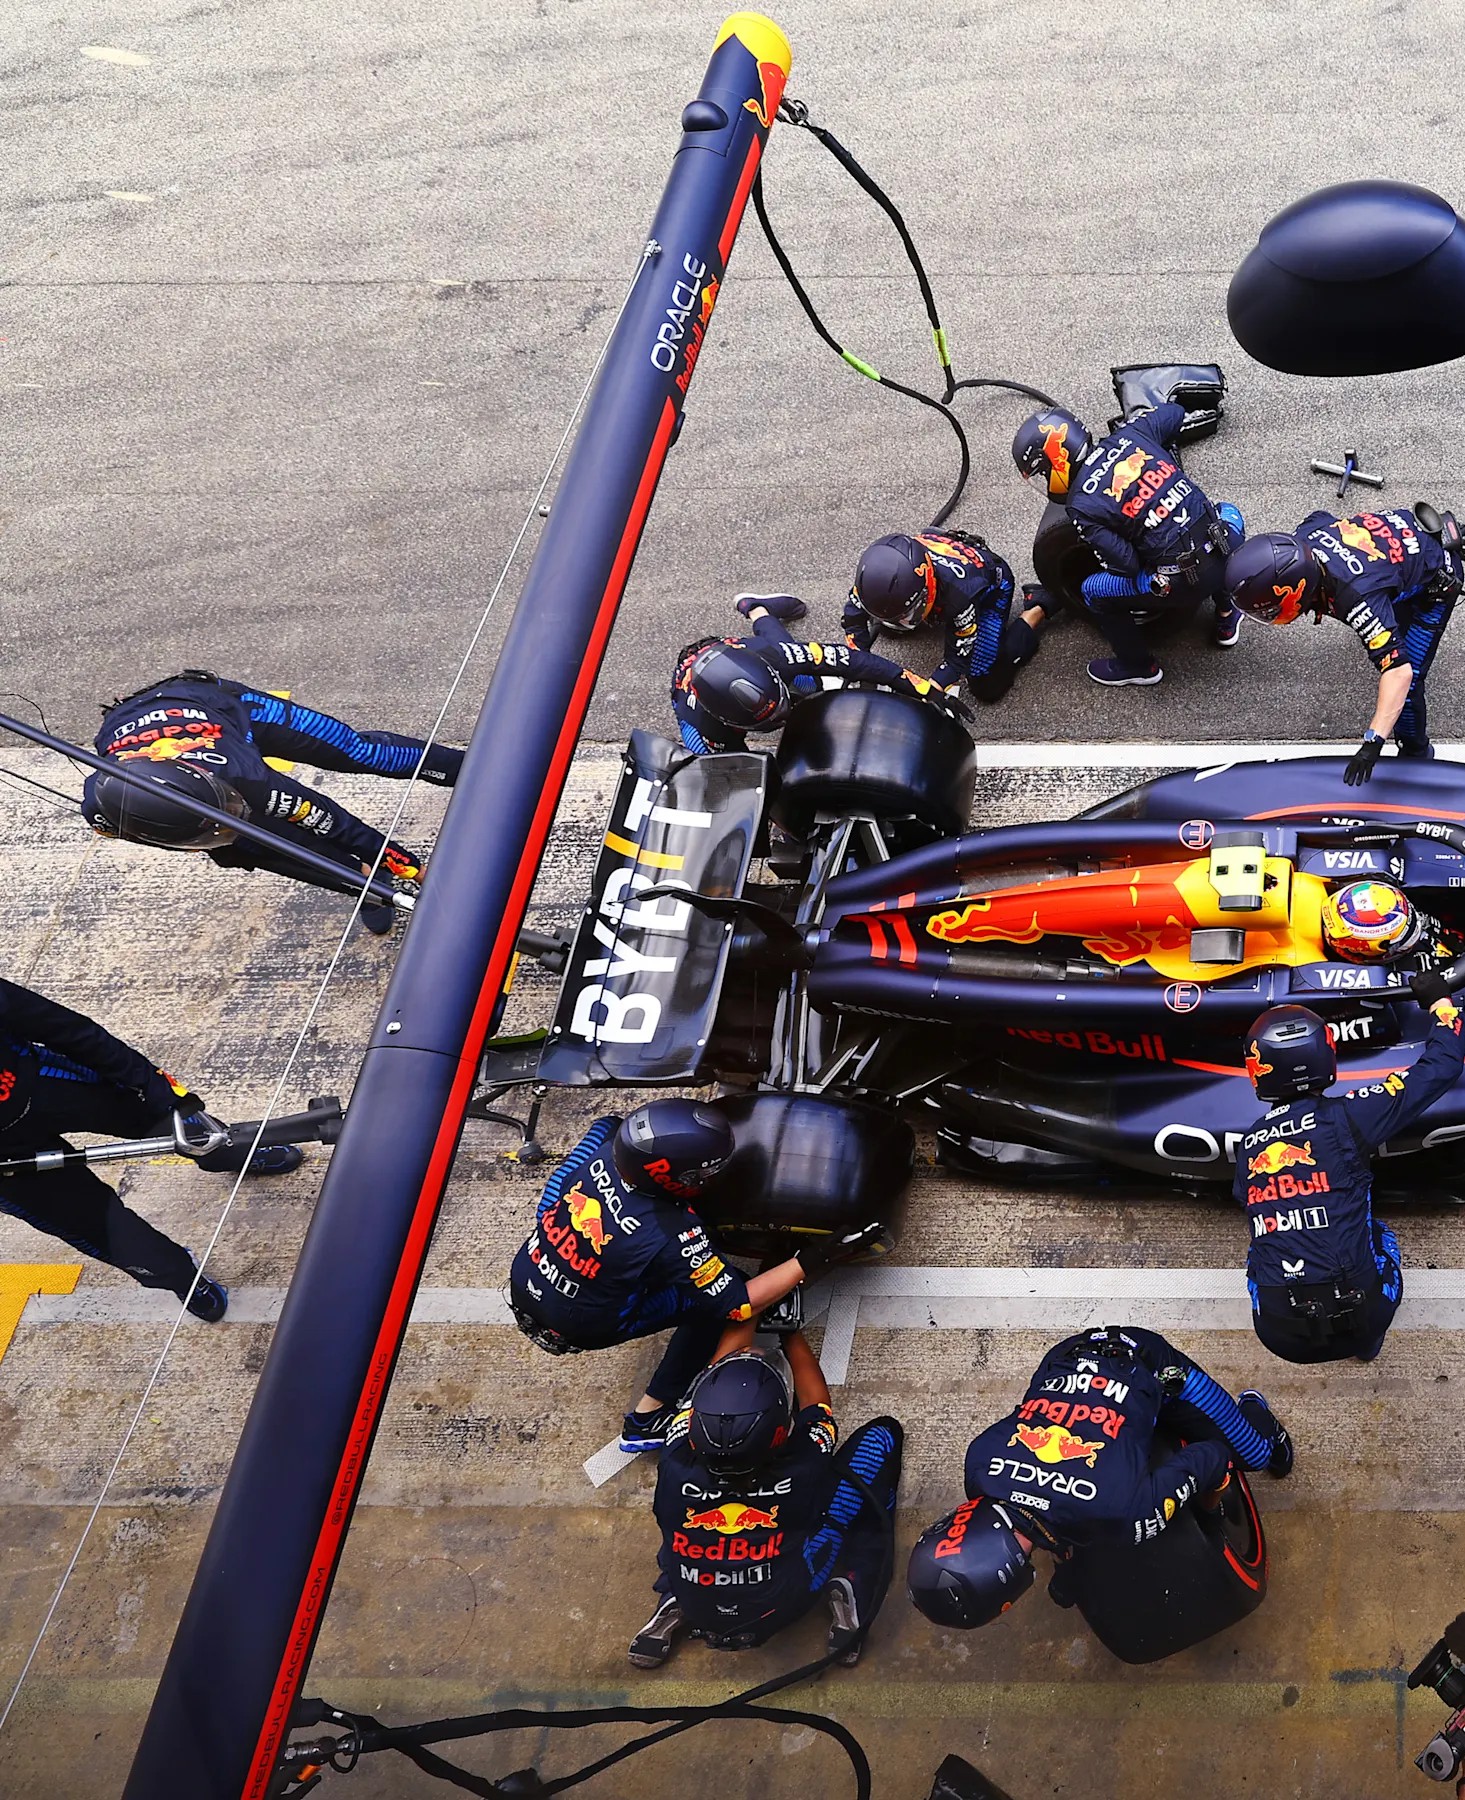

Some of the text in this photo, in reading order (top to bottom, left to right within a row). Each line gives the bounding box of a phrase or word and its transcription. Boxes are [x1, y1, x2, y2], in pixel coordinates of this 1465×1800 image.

[651, 252, 706, 372] ORACLE
[1082, 437, 1132, 494] ORACLE
[1121, 478, 1155, 519] Red
[1144, 489, 1183, 529] Mobil
[136, 708, 208, 728] Mobil
[1416, 822, 1453, 840] BYBIT
[1323, 852, 1378, 868] VISA
[570, 776, 712, 1045] BYBIT
[1315, 969, 1371, 988] VISA
[1331, 1017, 1373, 1042] OKT
[1085, 1031, 1165, 1061] Bull
[1265, 1104, 1290, 1120] sparco
[1244, 1112, 1317, 1149] ORACLE
[589, 1159, 641, 1235] ORACLE
[1278, 1172, 1330, 1199] Bull
[1252, 1208, 1302, 1238] Mobil
[527, 1230, 560, 1284] Mobil
[557, 1233, 601, 1279] Bull
[703, 1273, 733, 1297] VISA
[1062, 1373, 1130, 1404] Mobil
[1018, 1398, 1126, 1440] Red Bull
[331, 1352, 389, 1525] @REDBULLRACING
[988, 1457, 1097, 1501] ORACLE
[1010, 1491, 1050, 1511] sparco
[672, 1531, 784, 1560] Red Bull
[680, 1563, 745, 1587] Mobil
[250, 1567, 326, 1798] REDBULLRACING.COM
